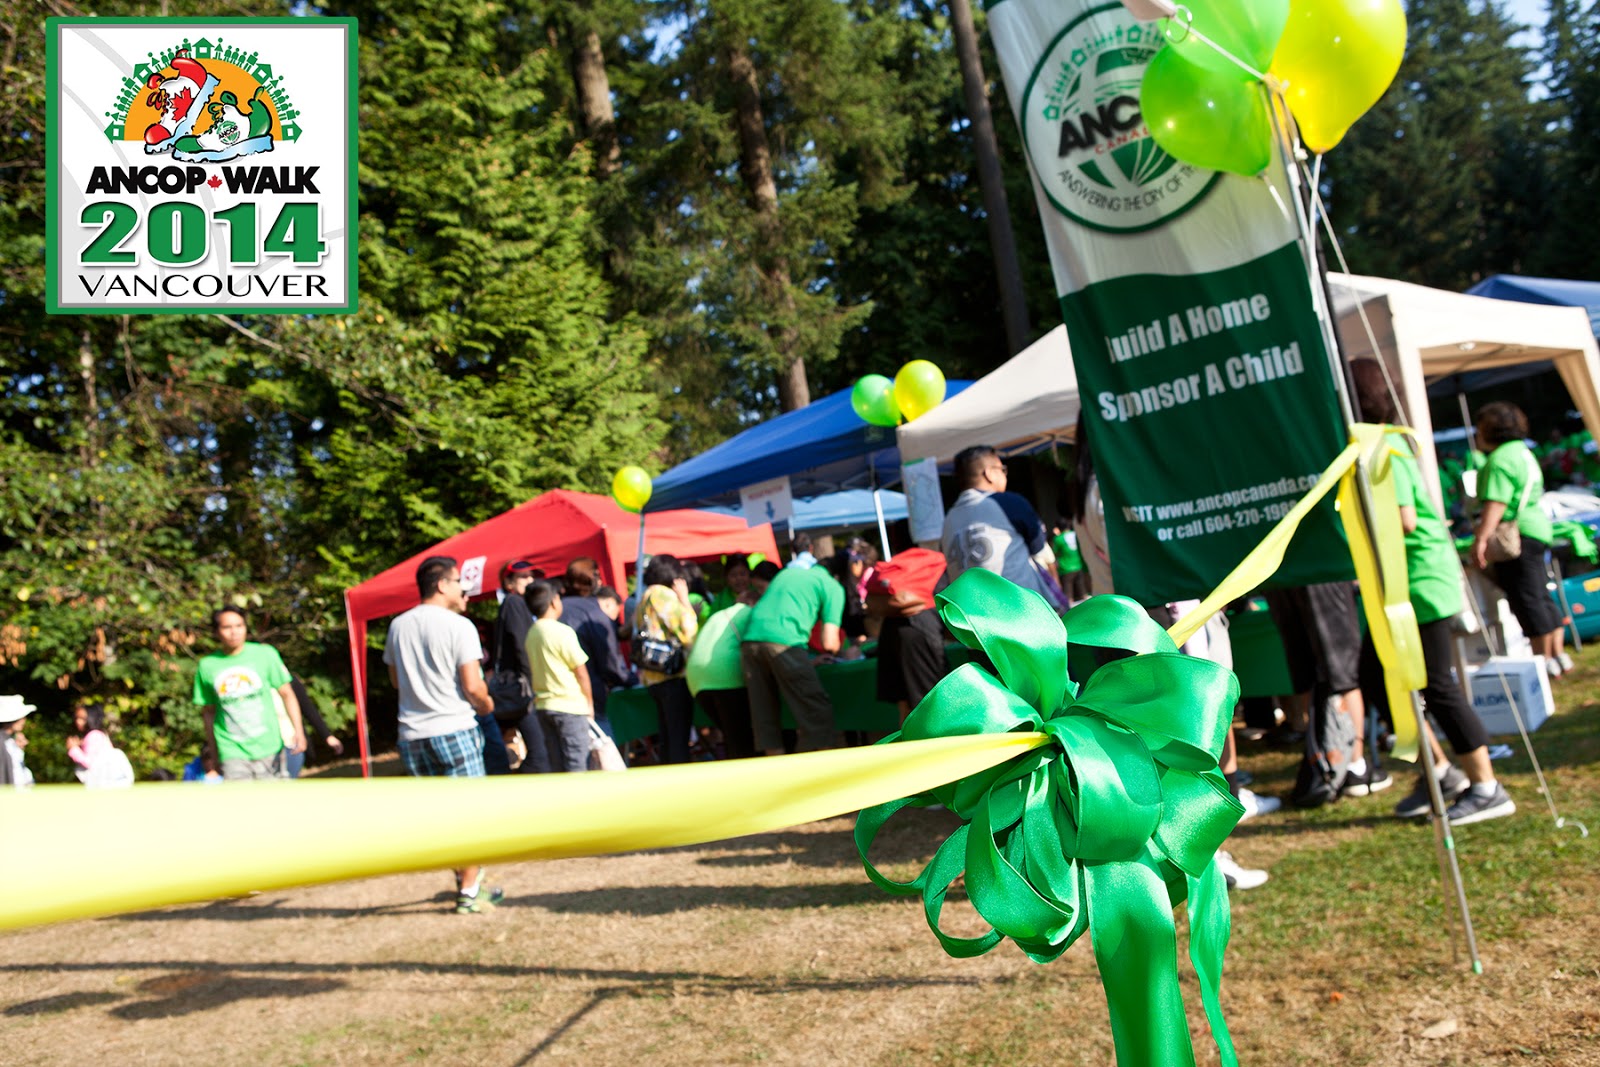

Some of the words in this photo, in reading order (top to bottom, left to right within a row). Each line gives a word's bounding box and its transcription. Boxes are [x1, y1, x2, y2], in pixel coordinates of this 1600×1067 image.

[1058, 95, 1143, 158] ANC
[1094, 125, 1149, 155] CANA
[1057, 169, 1122, 212] ANSWERING
[1123, 194, 1143, 210] THE
[1142, 186, 1165, 208] CRY
[1165, 175, 1184, 193] OF
[1105, 319, 1166, 364] uild
[1168, 313, 1189, 346] A
[1186, 293, 1271, 339] Home
[1098, 373, 1201, 422] Sponsor
[1204, 363, 1226, 396] A
[1225, 341, 1304, 390] Child
[1155, 472, 1322, 521] www.ancopcanada.co
[1157, 526, 1174, 542] or
[1176, 518, 1204, 540] call
